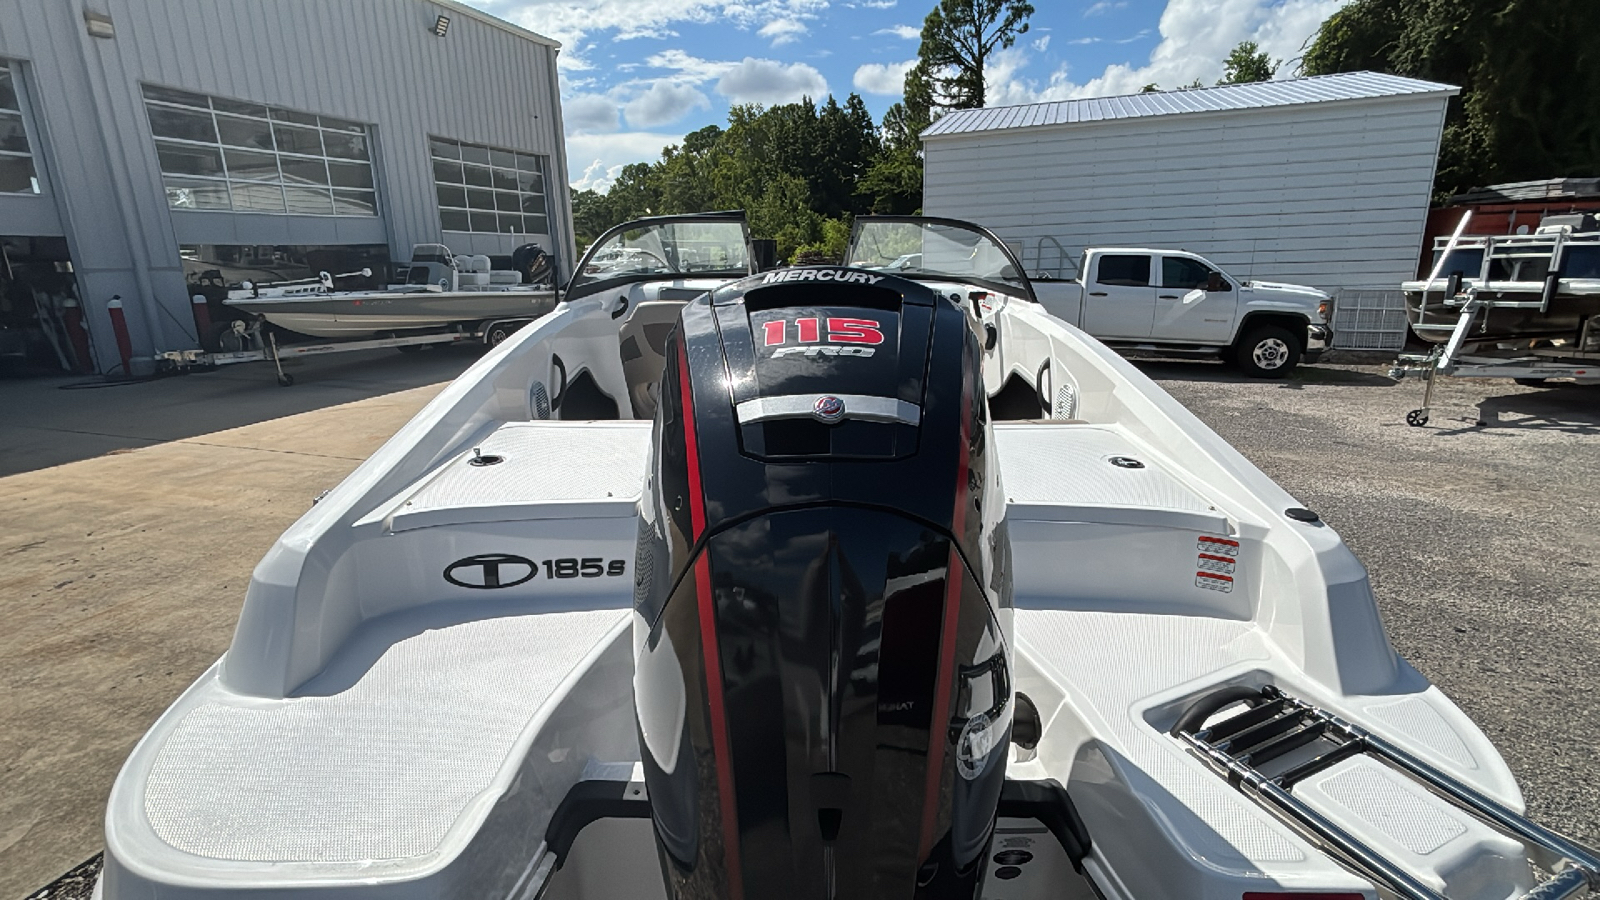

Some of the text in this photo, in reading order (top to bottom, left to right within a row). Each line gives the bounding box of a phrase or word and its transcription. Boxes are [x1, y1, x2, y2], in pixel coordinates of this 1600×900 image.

[761, 269, 886, 286] MERCURY
[762, 317, 885, 346] 115
[770, 346, 876, 359] PRO
